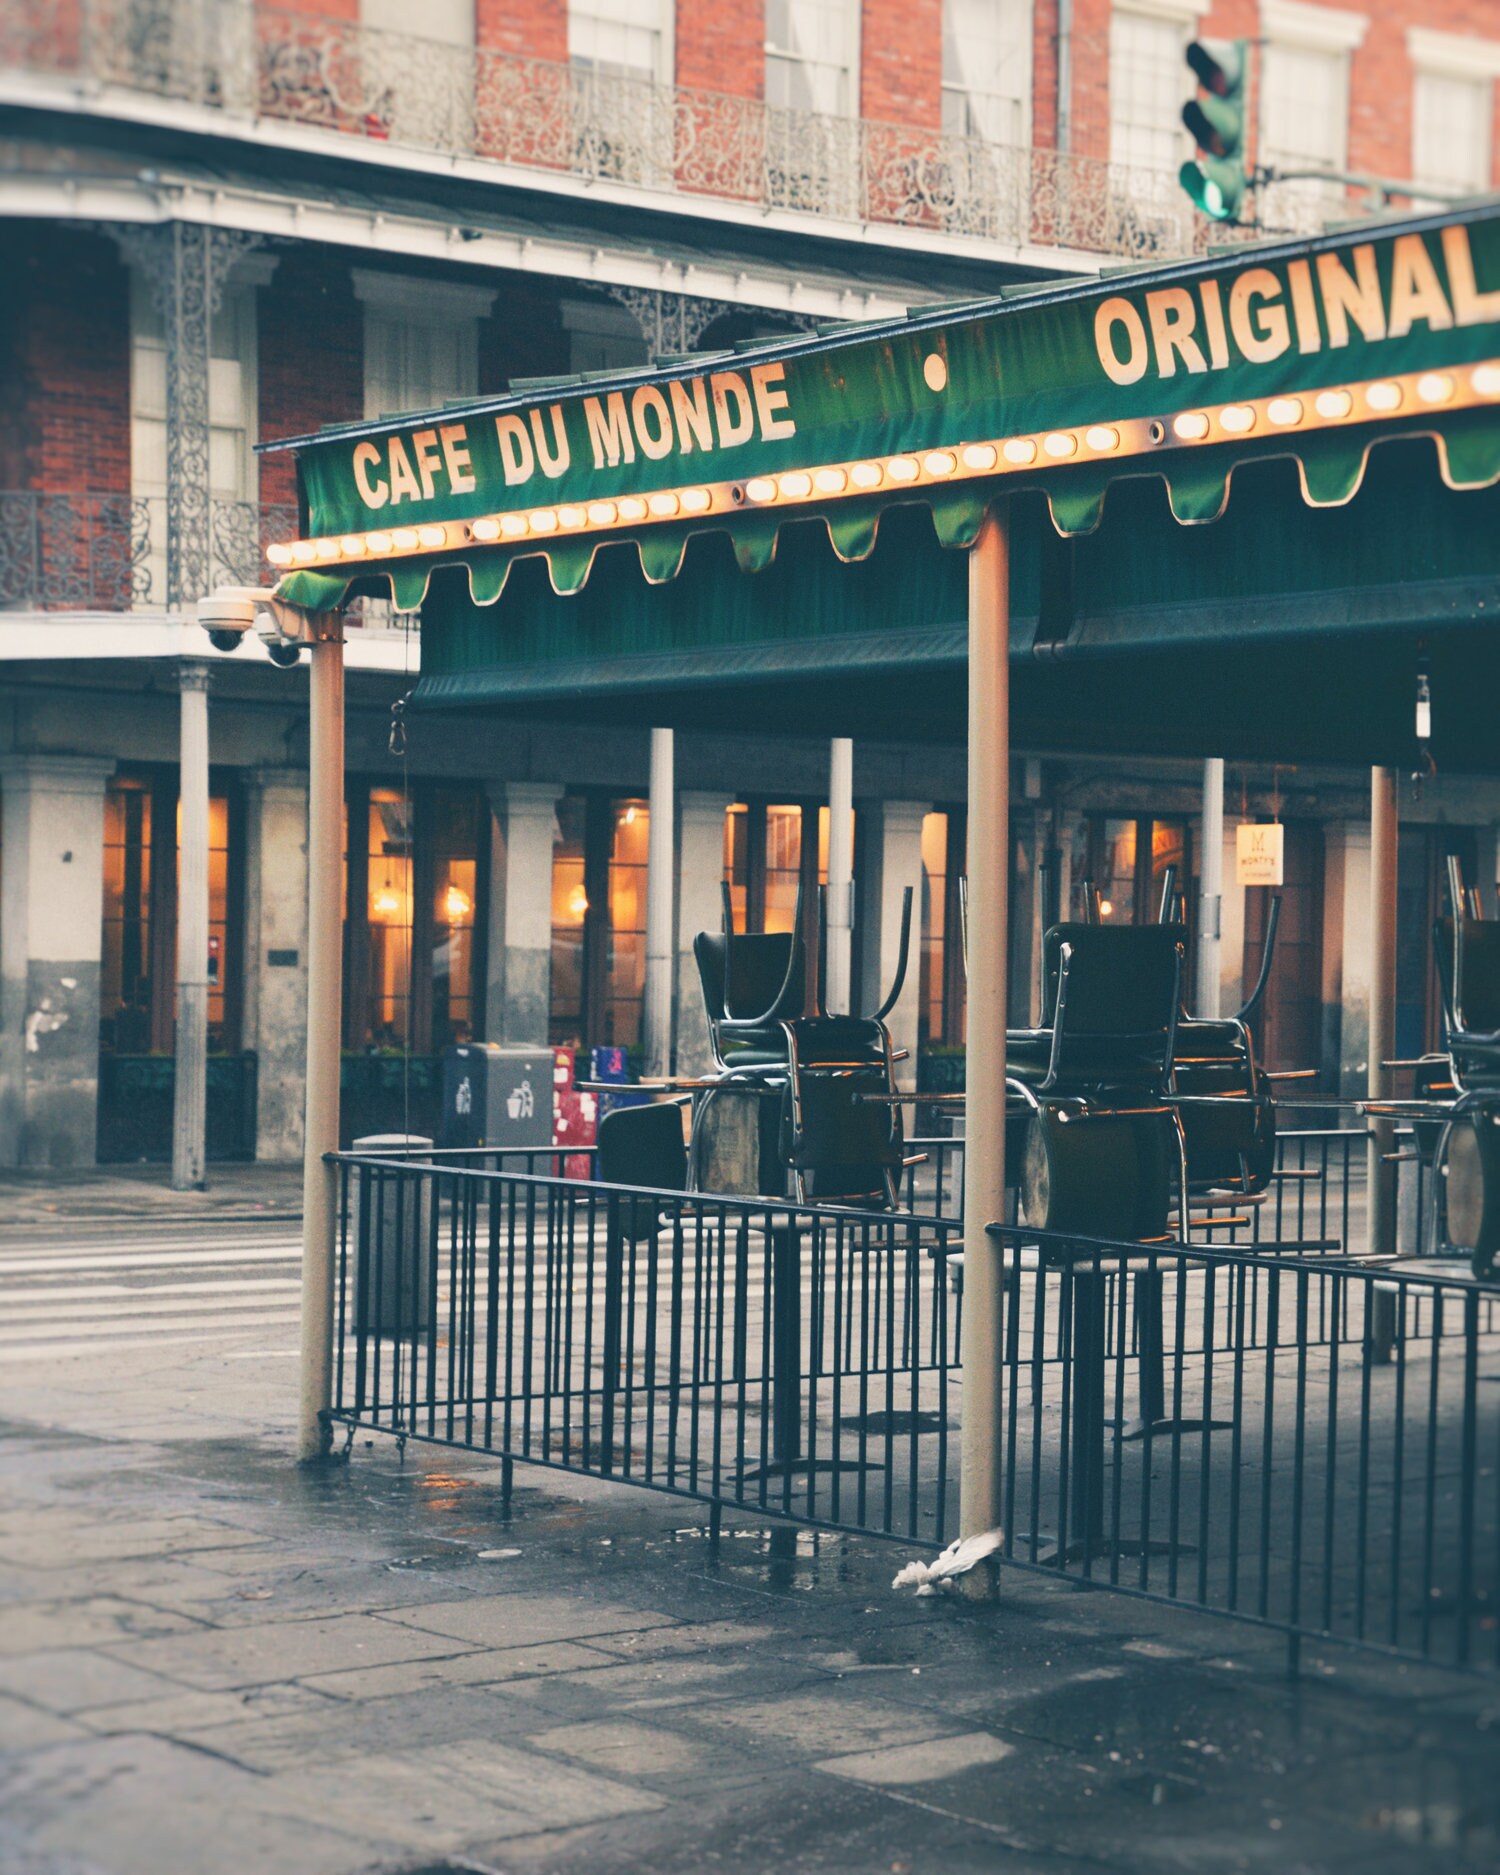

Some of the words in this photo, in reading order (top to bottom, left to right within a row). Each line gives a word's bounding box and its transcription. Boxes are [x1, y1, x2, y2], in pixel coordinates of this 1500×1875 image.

[352, 425, 476, 510] CAFE
[495, 404, 571, 486] DU
[584, 362, 797, 470] MONDE
[1094, 224, 1500, 386] ORIGINAL
